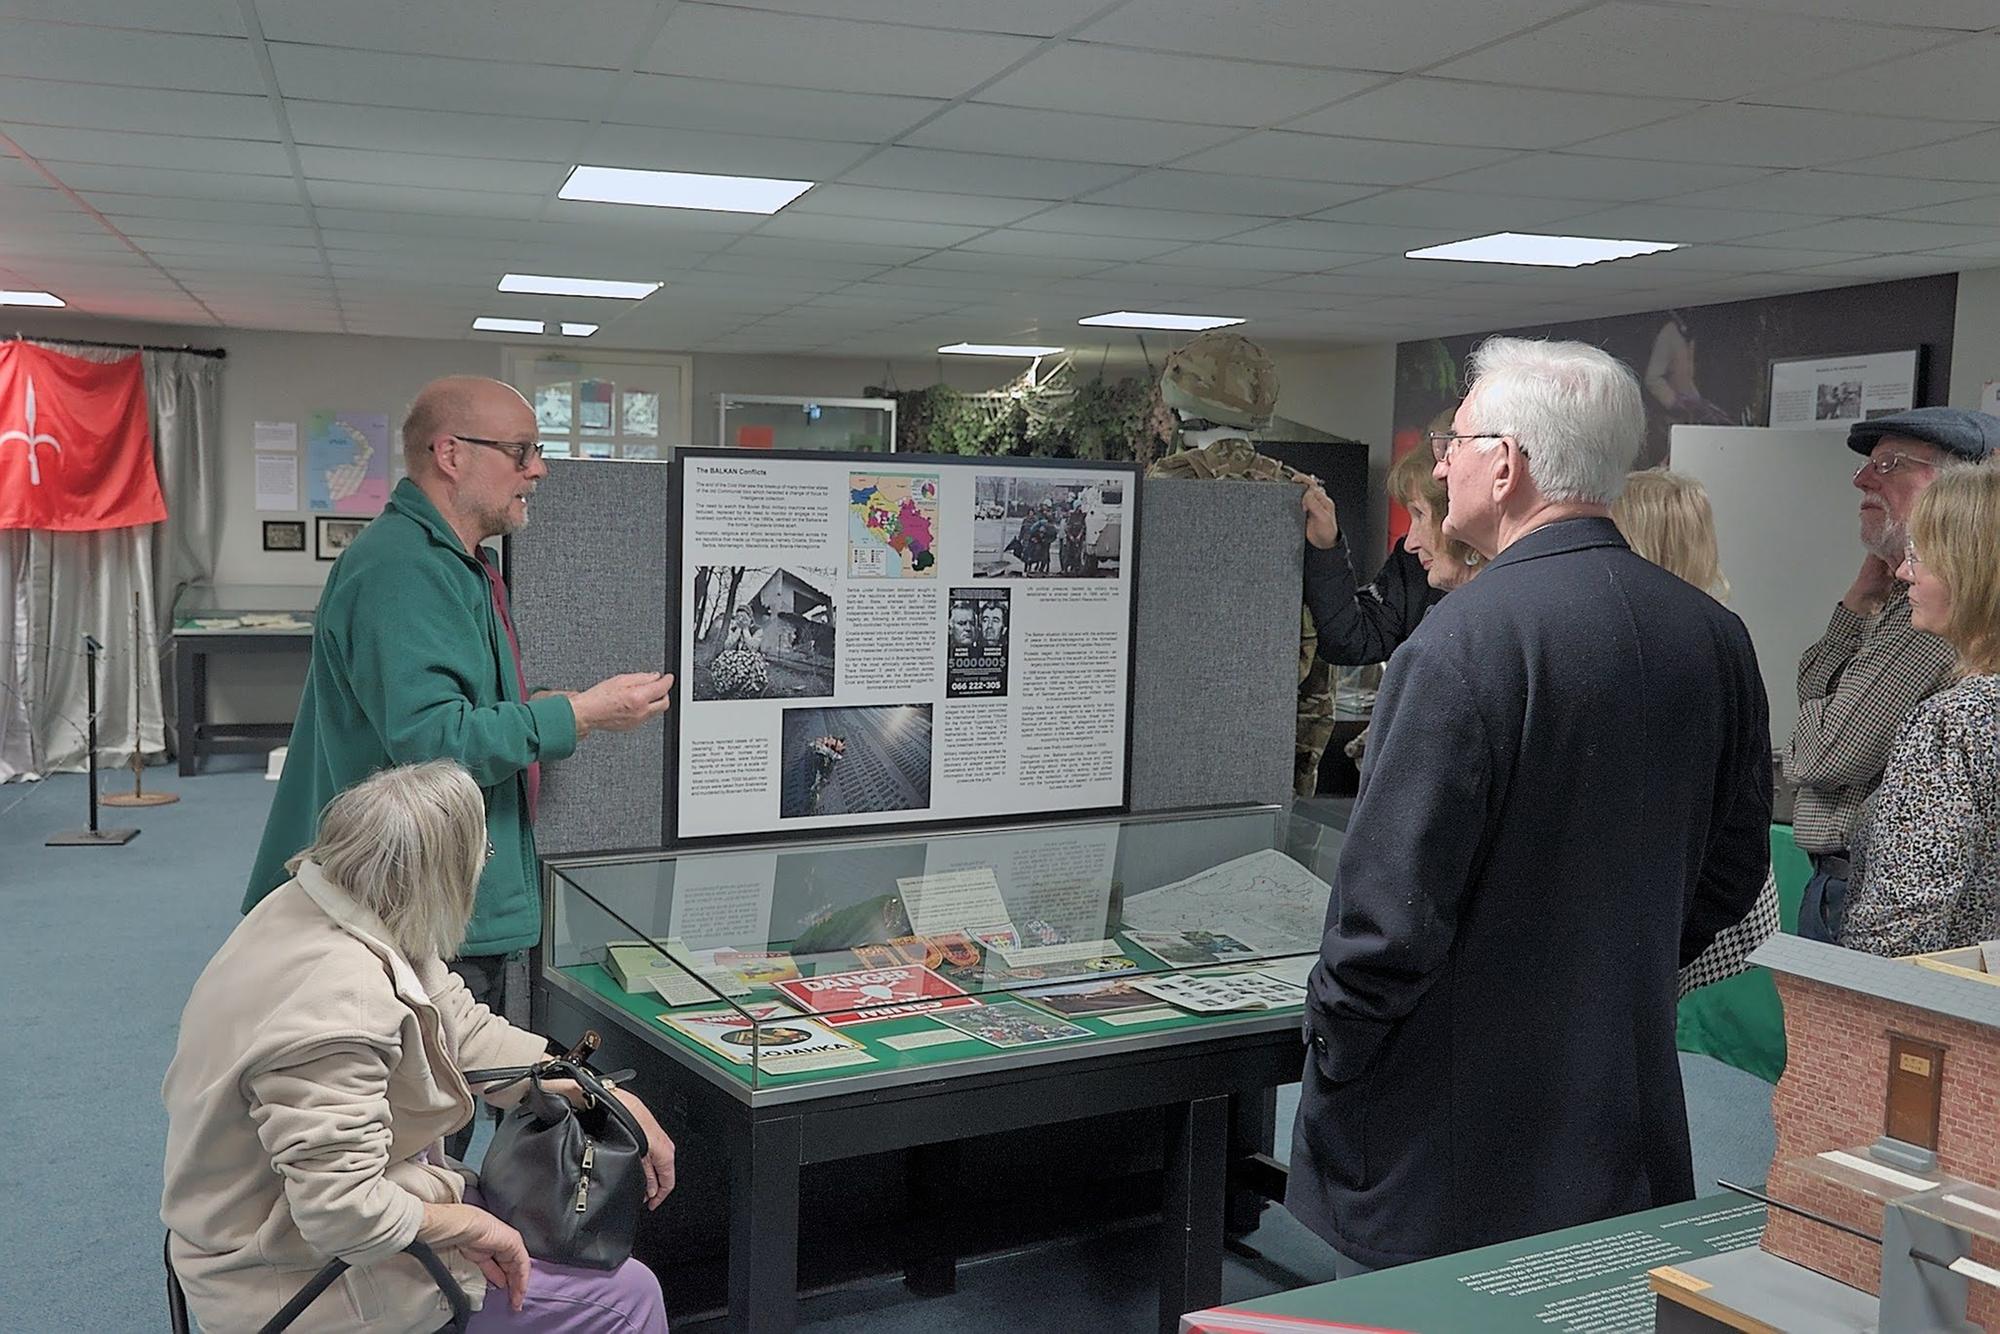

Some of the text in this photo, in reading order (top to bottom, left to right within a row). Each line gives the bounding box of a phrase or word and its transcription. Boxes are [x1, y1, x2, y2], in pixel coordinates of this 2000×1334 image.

[739, 468, 767, 476] Conflicts
[951, 682, 968, 690] 066
[800, 969, 915, 992] DANGER
[854, 994, 944, 1019] MINES
